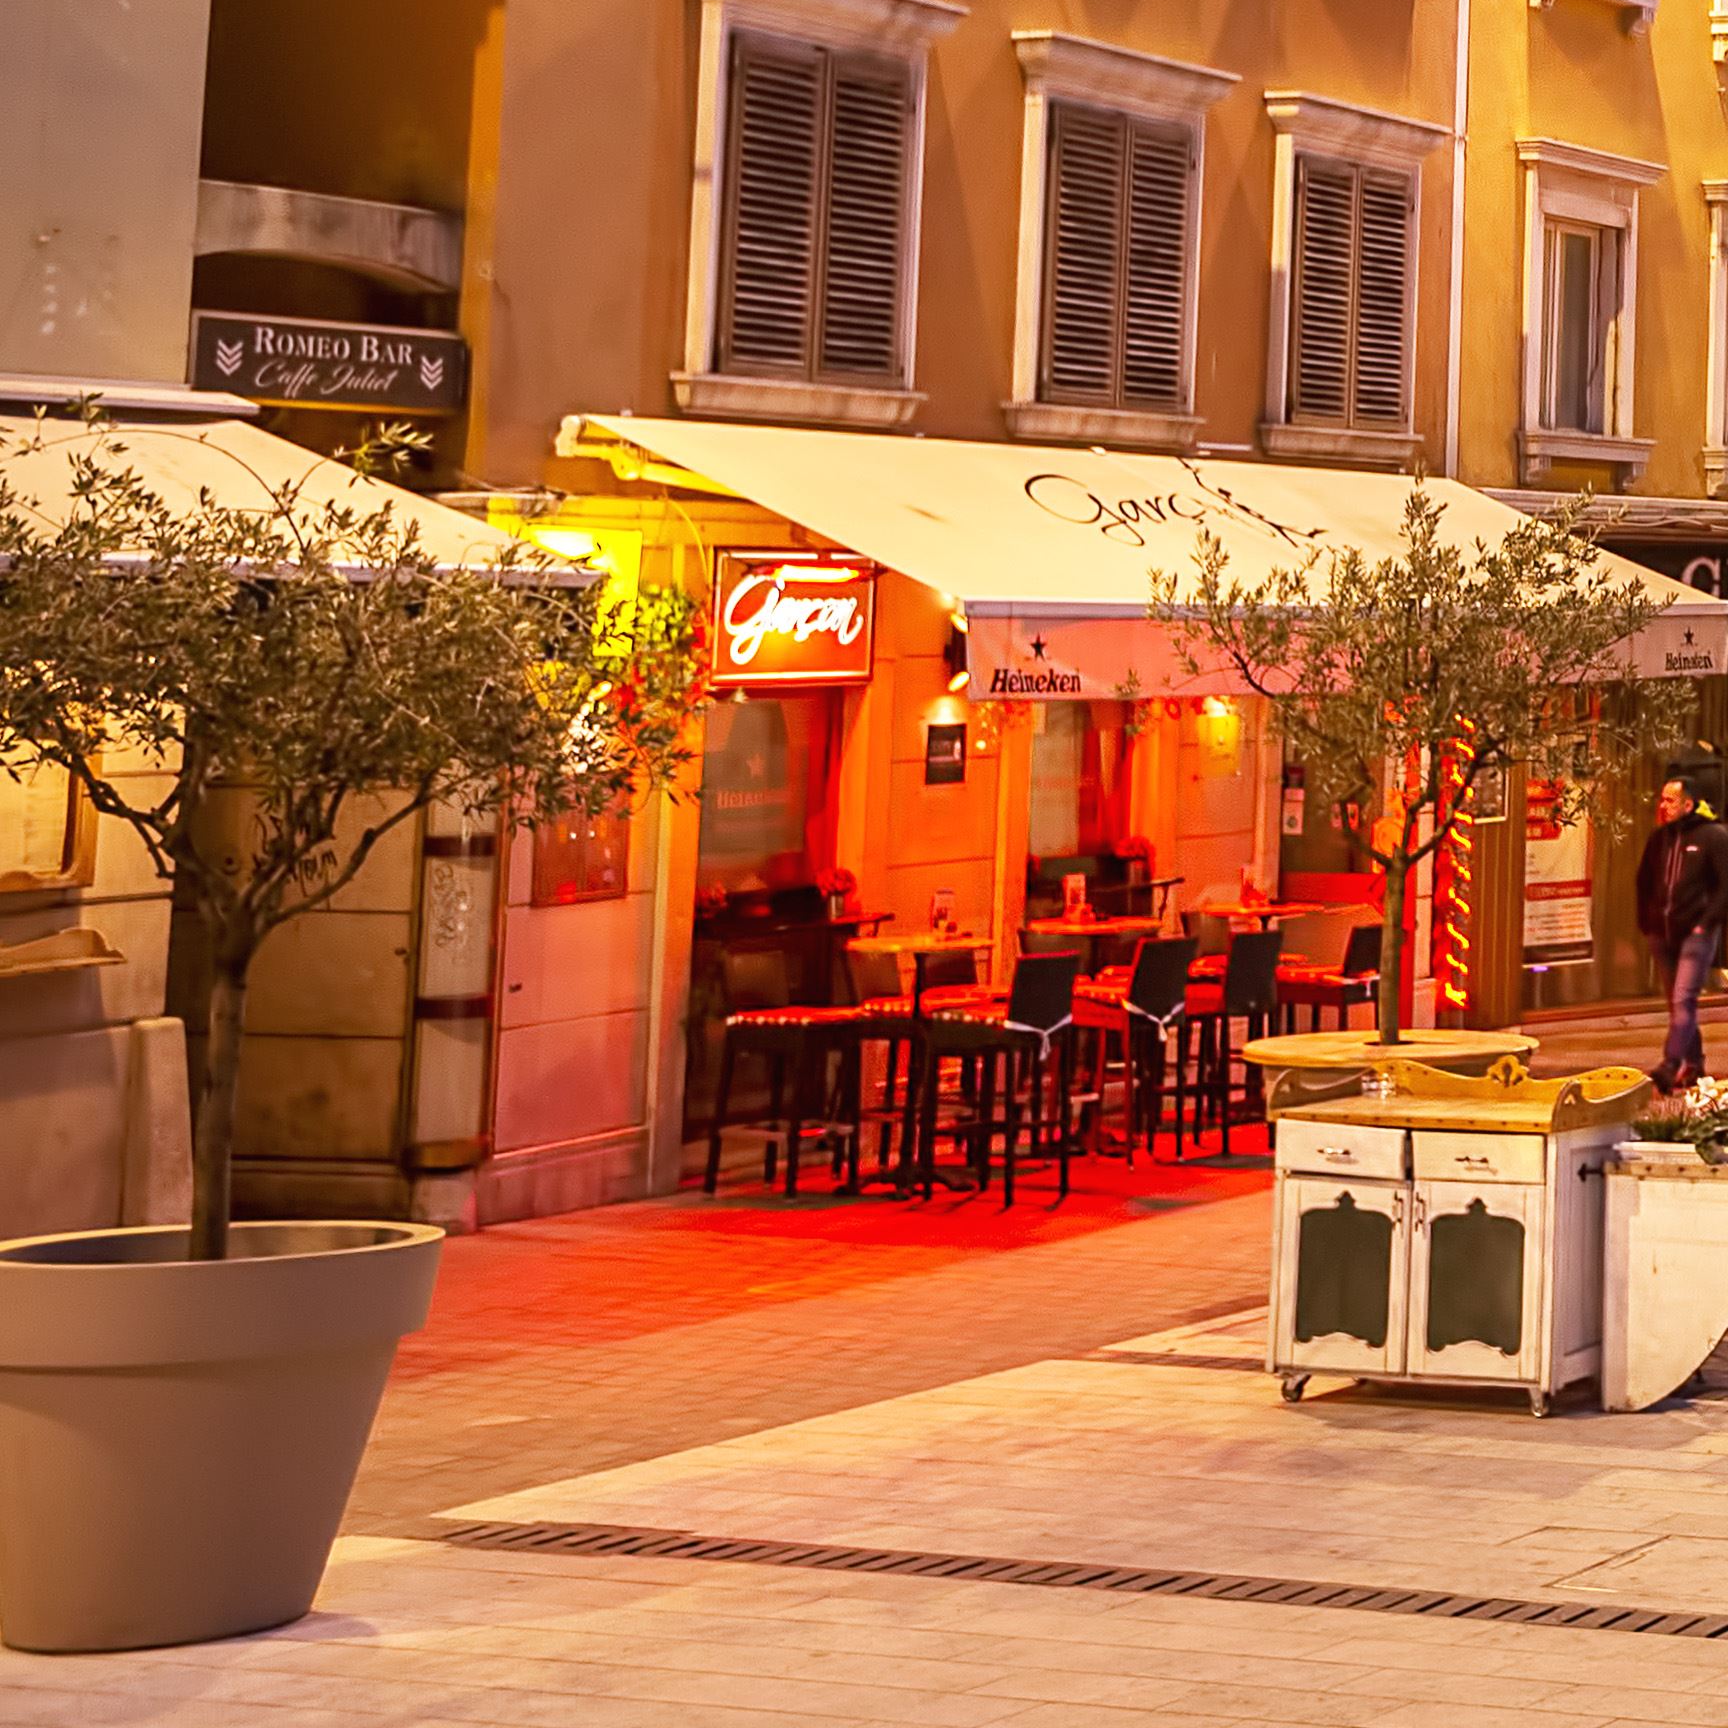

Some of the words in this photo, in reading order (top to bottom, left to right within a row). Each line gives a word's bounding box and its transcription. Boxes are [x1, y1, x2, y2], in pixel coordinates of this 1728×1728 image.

[254, 326, 350, 360] ROMEO
[360, 335, 413, 365] BAR
[320, 364, 398, 395] Juliet
[990, 668, 1082, 693] Heineken
